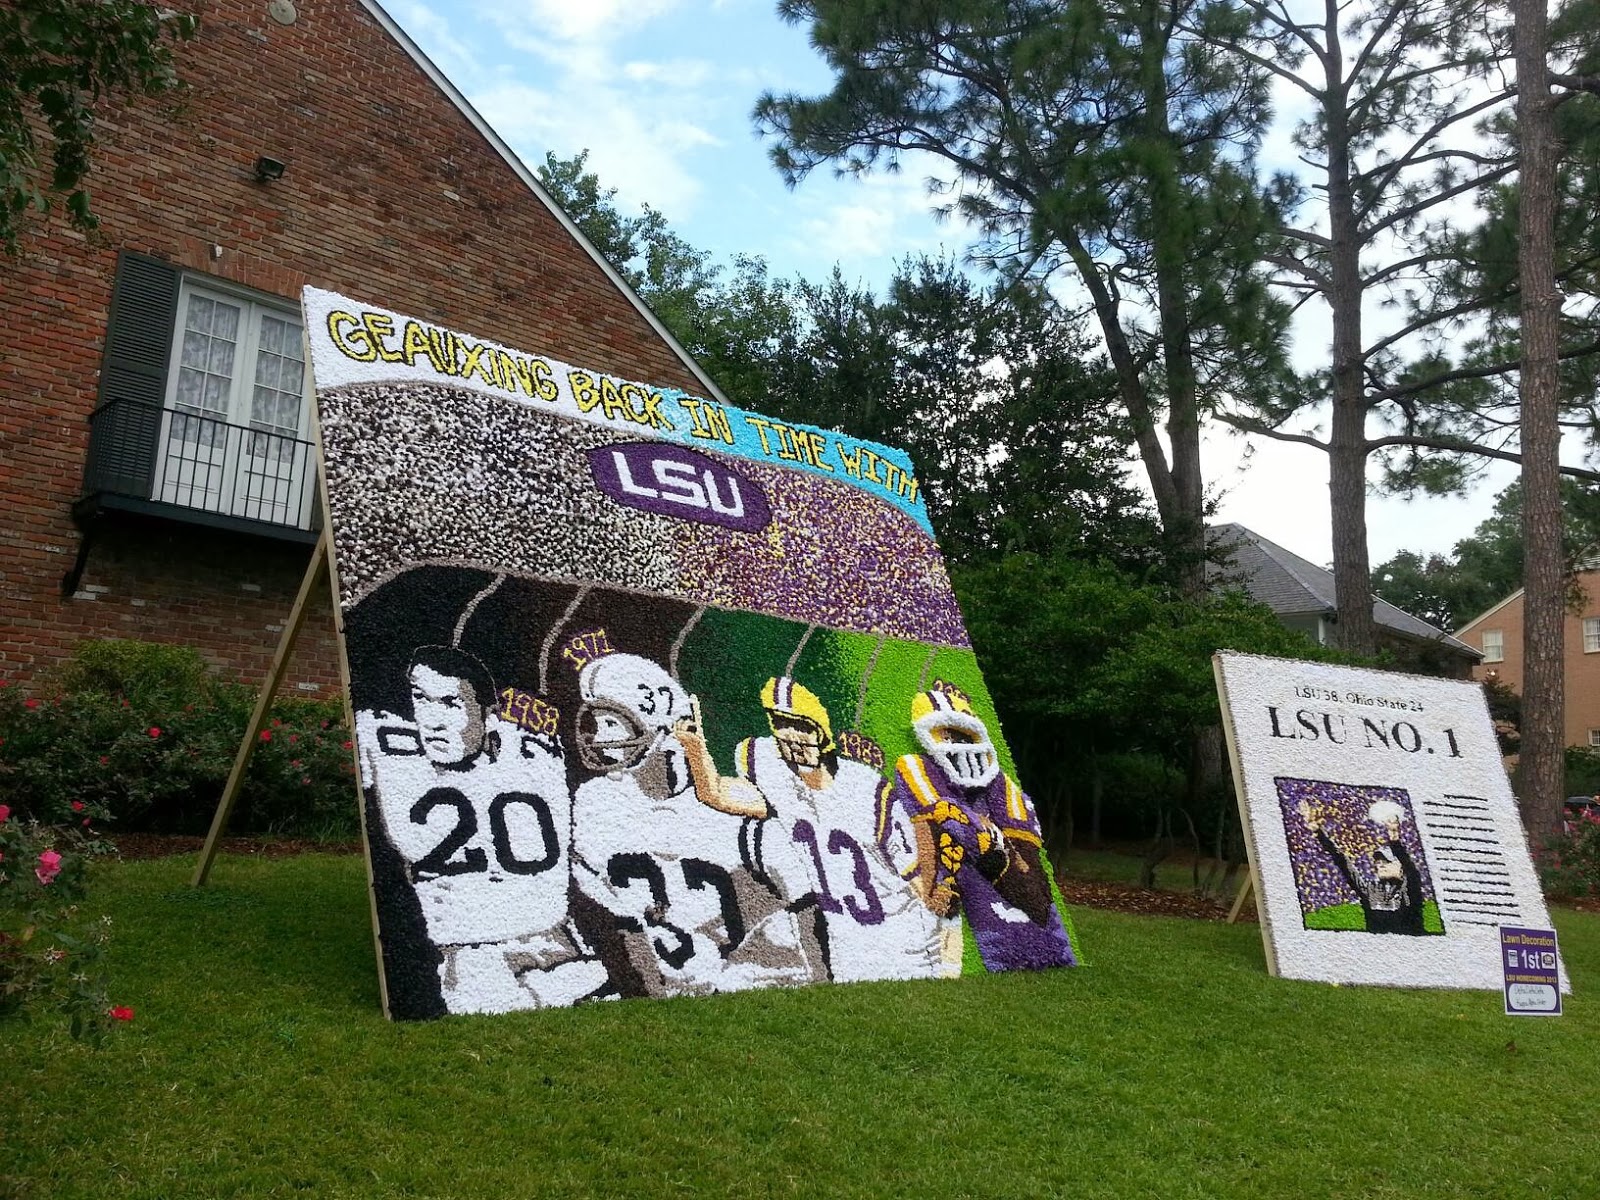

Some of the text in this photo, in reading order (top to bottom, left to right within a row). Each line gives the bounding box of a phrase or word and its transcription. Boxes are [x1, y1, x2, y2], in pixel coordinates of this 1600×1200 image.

[327, 309, 919, 504] GEAUXING BACK IN TIME WITH
[612, 451, 744, 518] LSU
[563, 628, 616, 671] 1971
[501, 687, 560, 736] 1958
[1294, 686, 1321, 700] LSU
[1345, 691, 1375, 707] Ohio
[1376, 696, 1408, 712] State
[1409, 700, 1425, 713] 24
[1264, 705, 1465, 760] LSU NO. 1
[410, 787, 560, 883] 20
[792, 818, 886, 926] 13
[1502, 932, 1554, 946] Lawn Decoration
[1522, 949, 1540, 970] 1st
